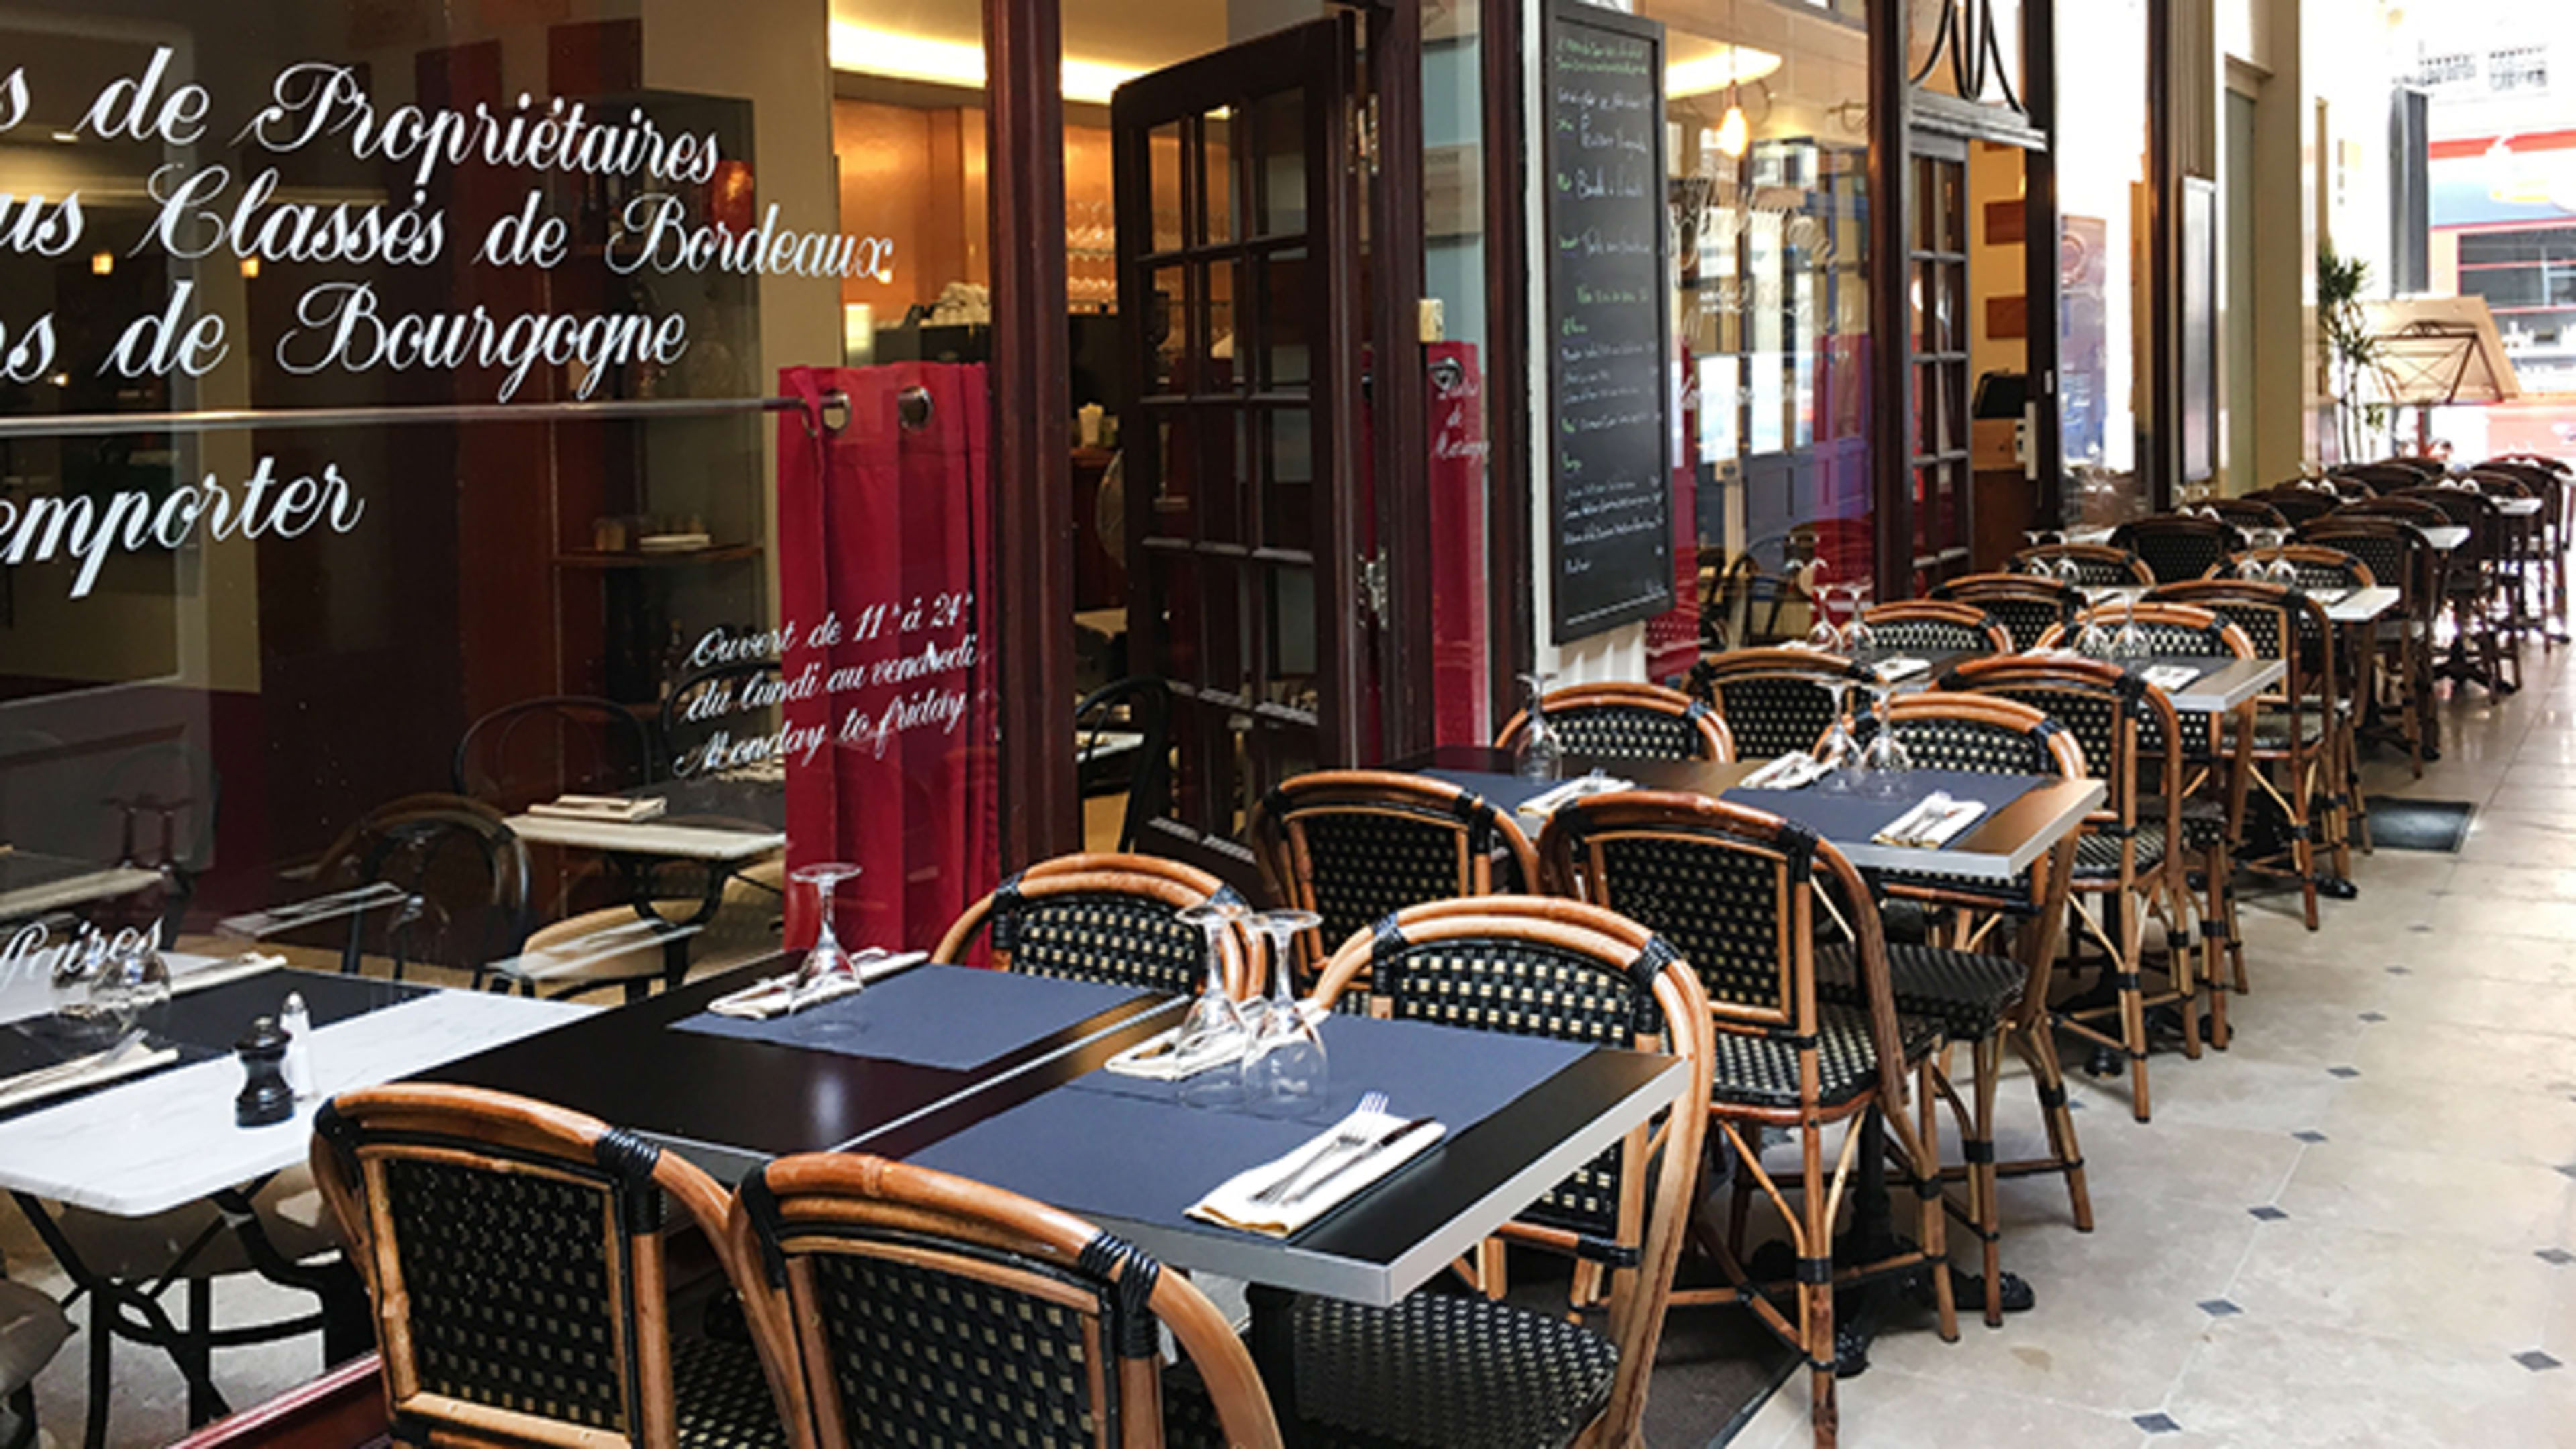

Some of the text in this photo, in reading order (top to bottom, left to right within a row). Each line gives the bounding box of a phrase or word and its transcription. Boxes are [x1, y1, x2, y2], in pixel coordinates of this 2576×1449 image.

[71, 46, 210, 146] de
[227, 62, 720, 186] Propriétaires
[127, 165, 445, 265] Classés
[471, 189, 568, 269] de
[604, 193, 894, 284] Bordeaux
[96, 279, 229, 378] de
[276, 280, 689, 403] Bourgogne
[678, 633, 978, 724] du lundi au vendredi
[680, 619, 798, 669] Ouvert
[804, 610, 841, 649] de
[672, 687, 967, 778] Monday to friday
